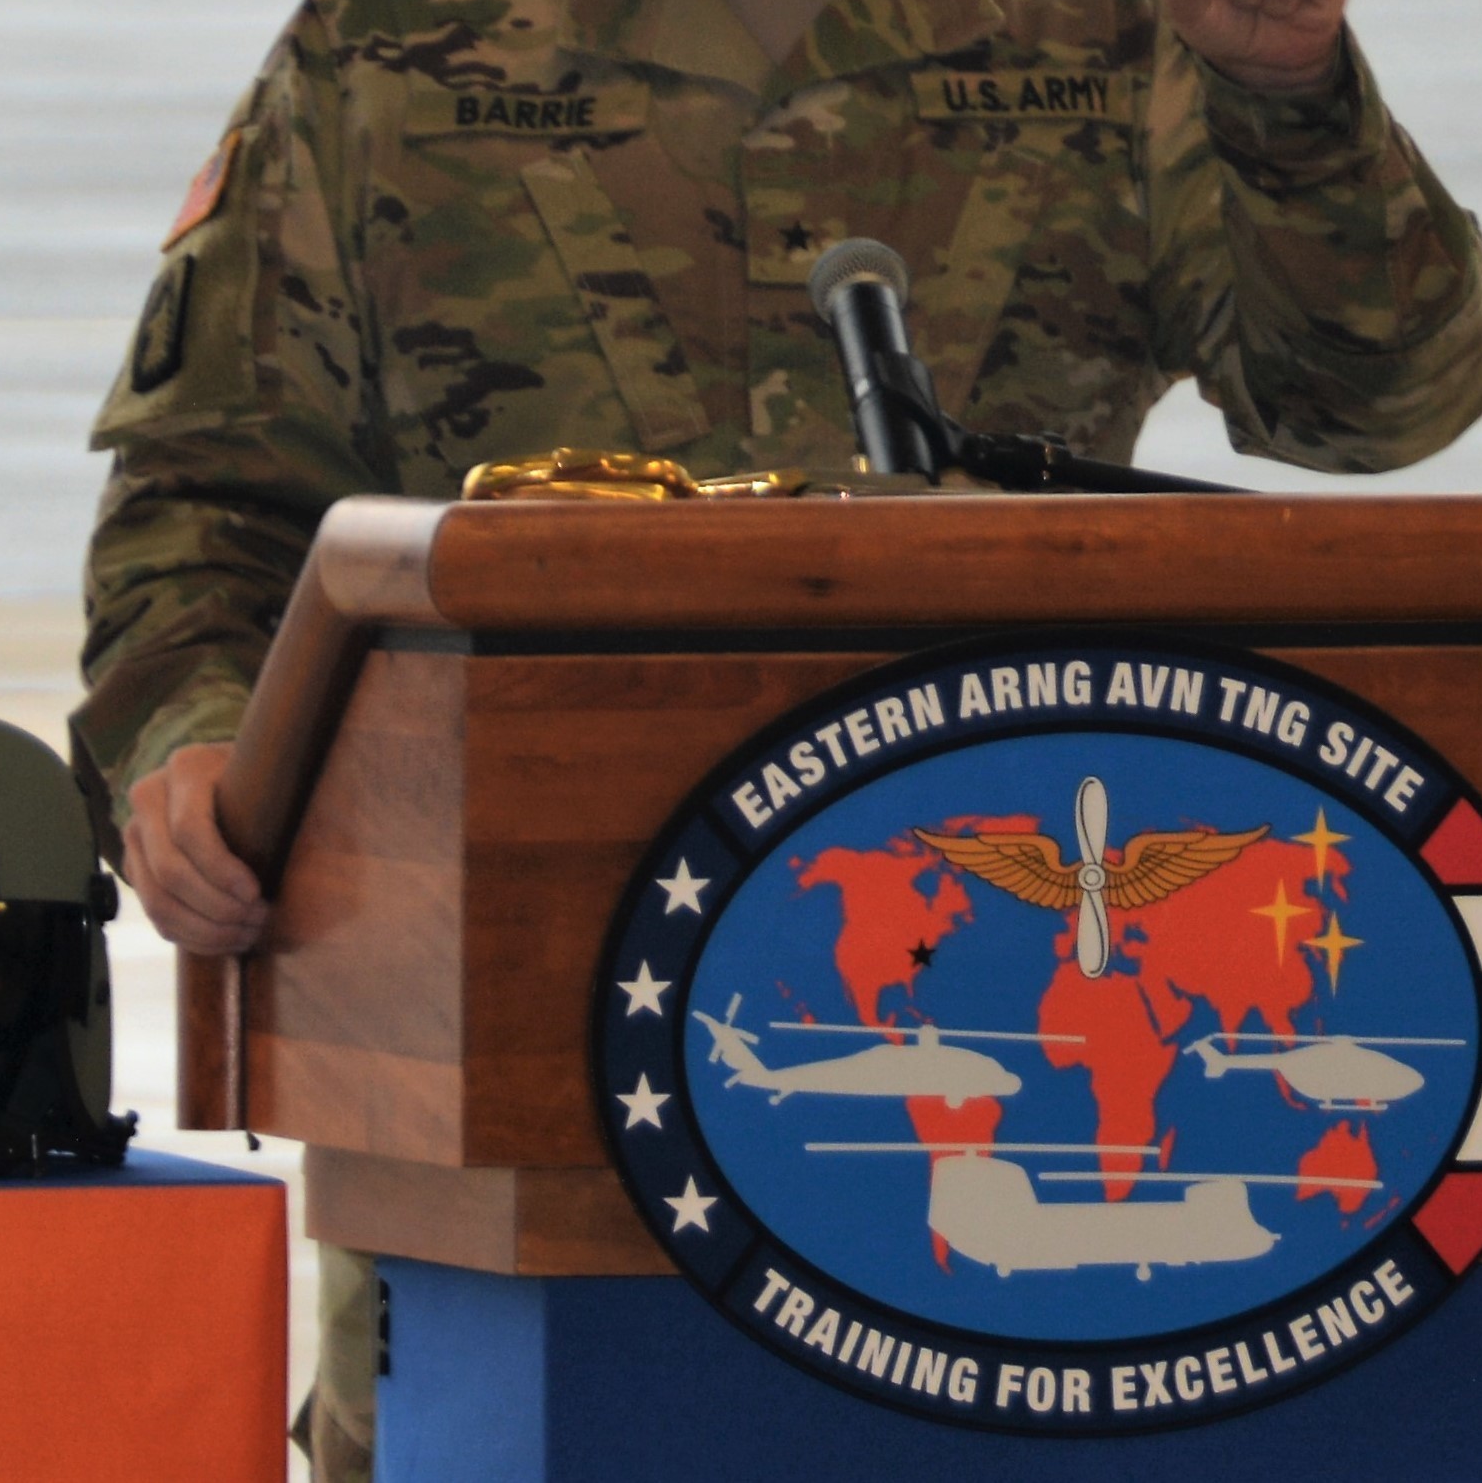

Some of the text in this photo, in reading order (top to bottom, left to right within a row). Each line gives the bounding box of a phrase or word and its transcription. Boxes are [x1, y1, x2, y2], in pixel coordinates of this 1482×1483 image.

[455, 96, 596, 128] BARRIE
[942, 75, 1109, 113] U.S. ARMY
[730, 659, 1426, 830] EASTERN ARNG AVN TNG SITE
[752, 1258, 1415, 1414] TRAINING FOR EXCELLENCE
